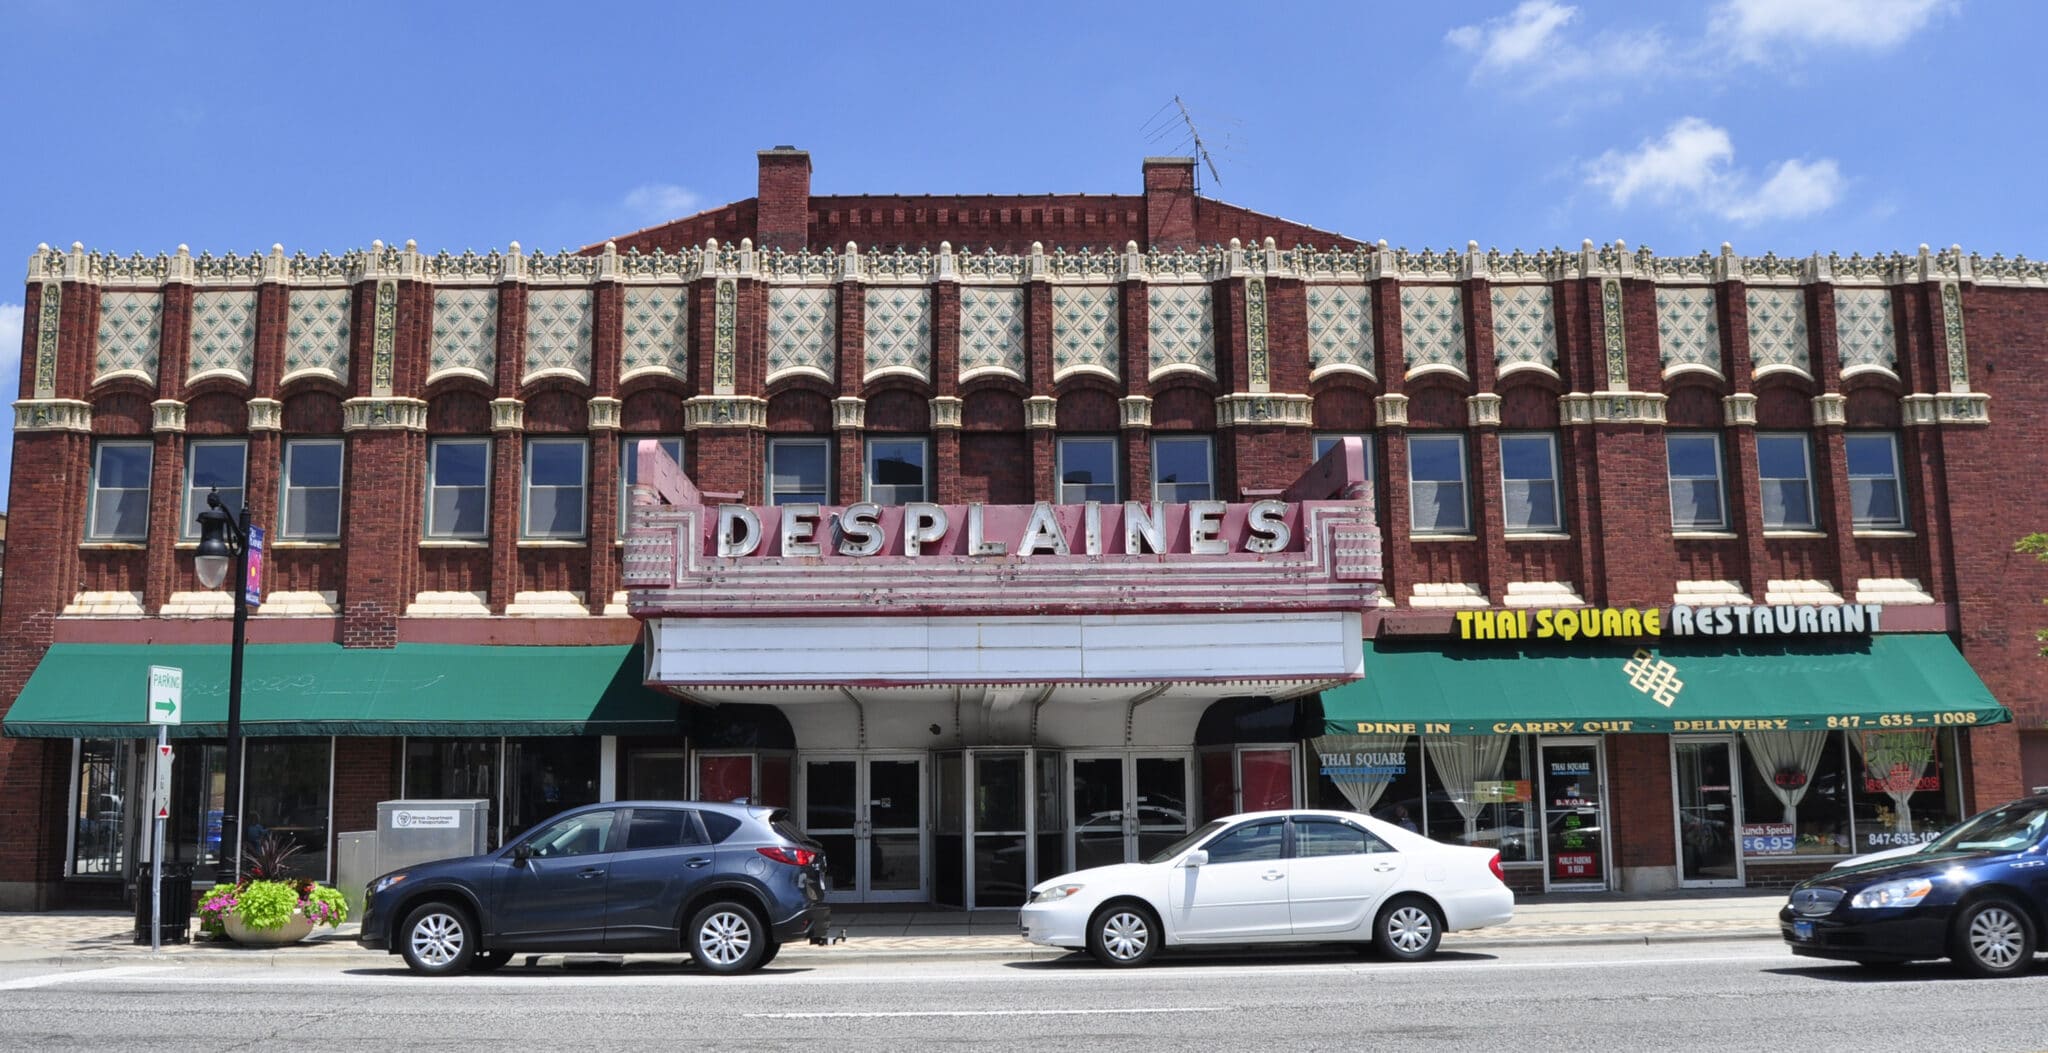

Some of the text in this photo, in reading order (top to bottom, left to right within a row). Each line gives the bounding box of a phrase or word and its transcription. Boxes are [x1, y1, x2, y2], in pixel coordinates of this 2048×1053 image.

[1456, 604, 1882, 641] THAI SQUARE RESTAURANT
[153, 673, 180, 688] PARKING
[1356, 722, 1416, 734] DINE
[1424, 723, 1451, 734] IN
[1492, 721, 1575, 733] CARRY
[1582, 720, 1634, 732] OUT
[1673, 719, 1789, 731] DELIVERY
[1320, 752, 1406, 768] THAI SQUARE
[1551, 762, 1590, 772] THAI SQUARE
[1741, 824, 1793, 837] Lunch Special
